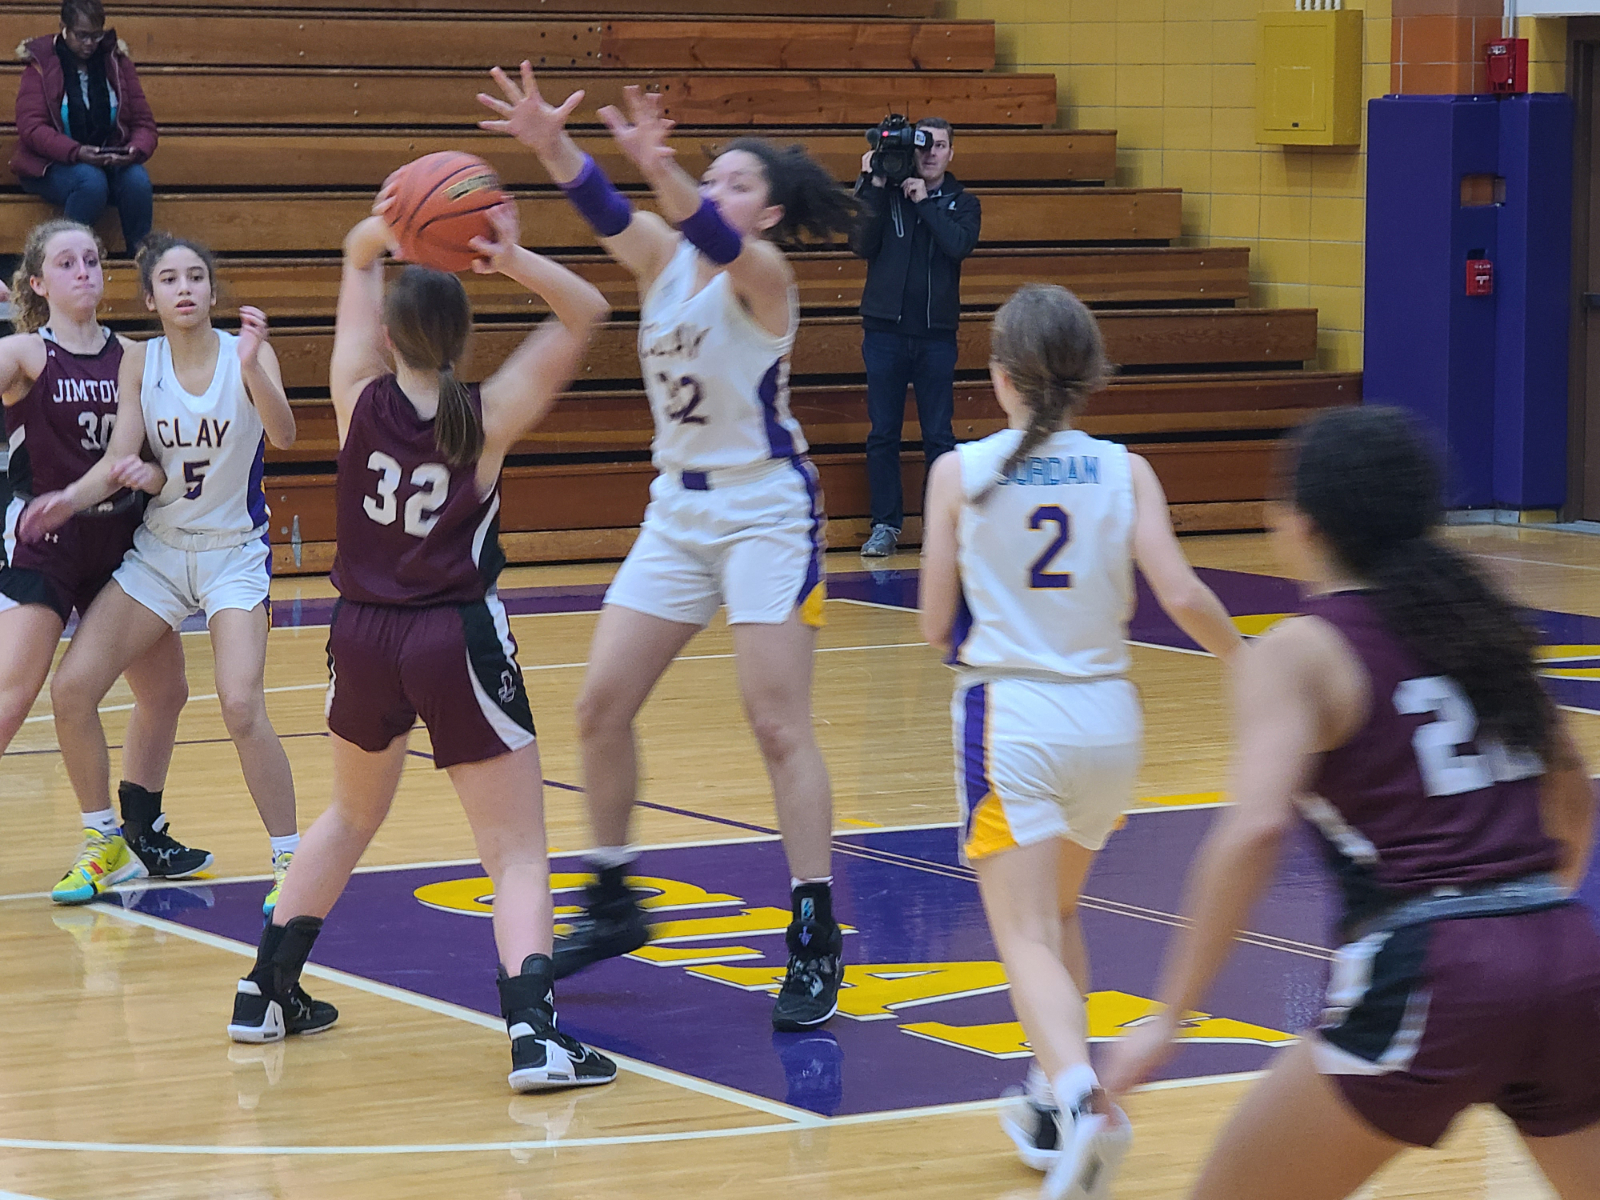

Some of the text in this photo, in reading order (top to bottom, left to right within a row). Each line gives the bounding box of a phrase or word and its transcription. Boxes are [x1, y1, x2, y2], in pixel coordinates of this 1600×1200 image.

[157, 418, 231, 449] CLAY
[182, 460, 210, 500] 5
[997, 456, 1100, 485] ORDAN
[363, 450, 450, 538] 32
[1027, 503, 1072, 590] 2
